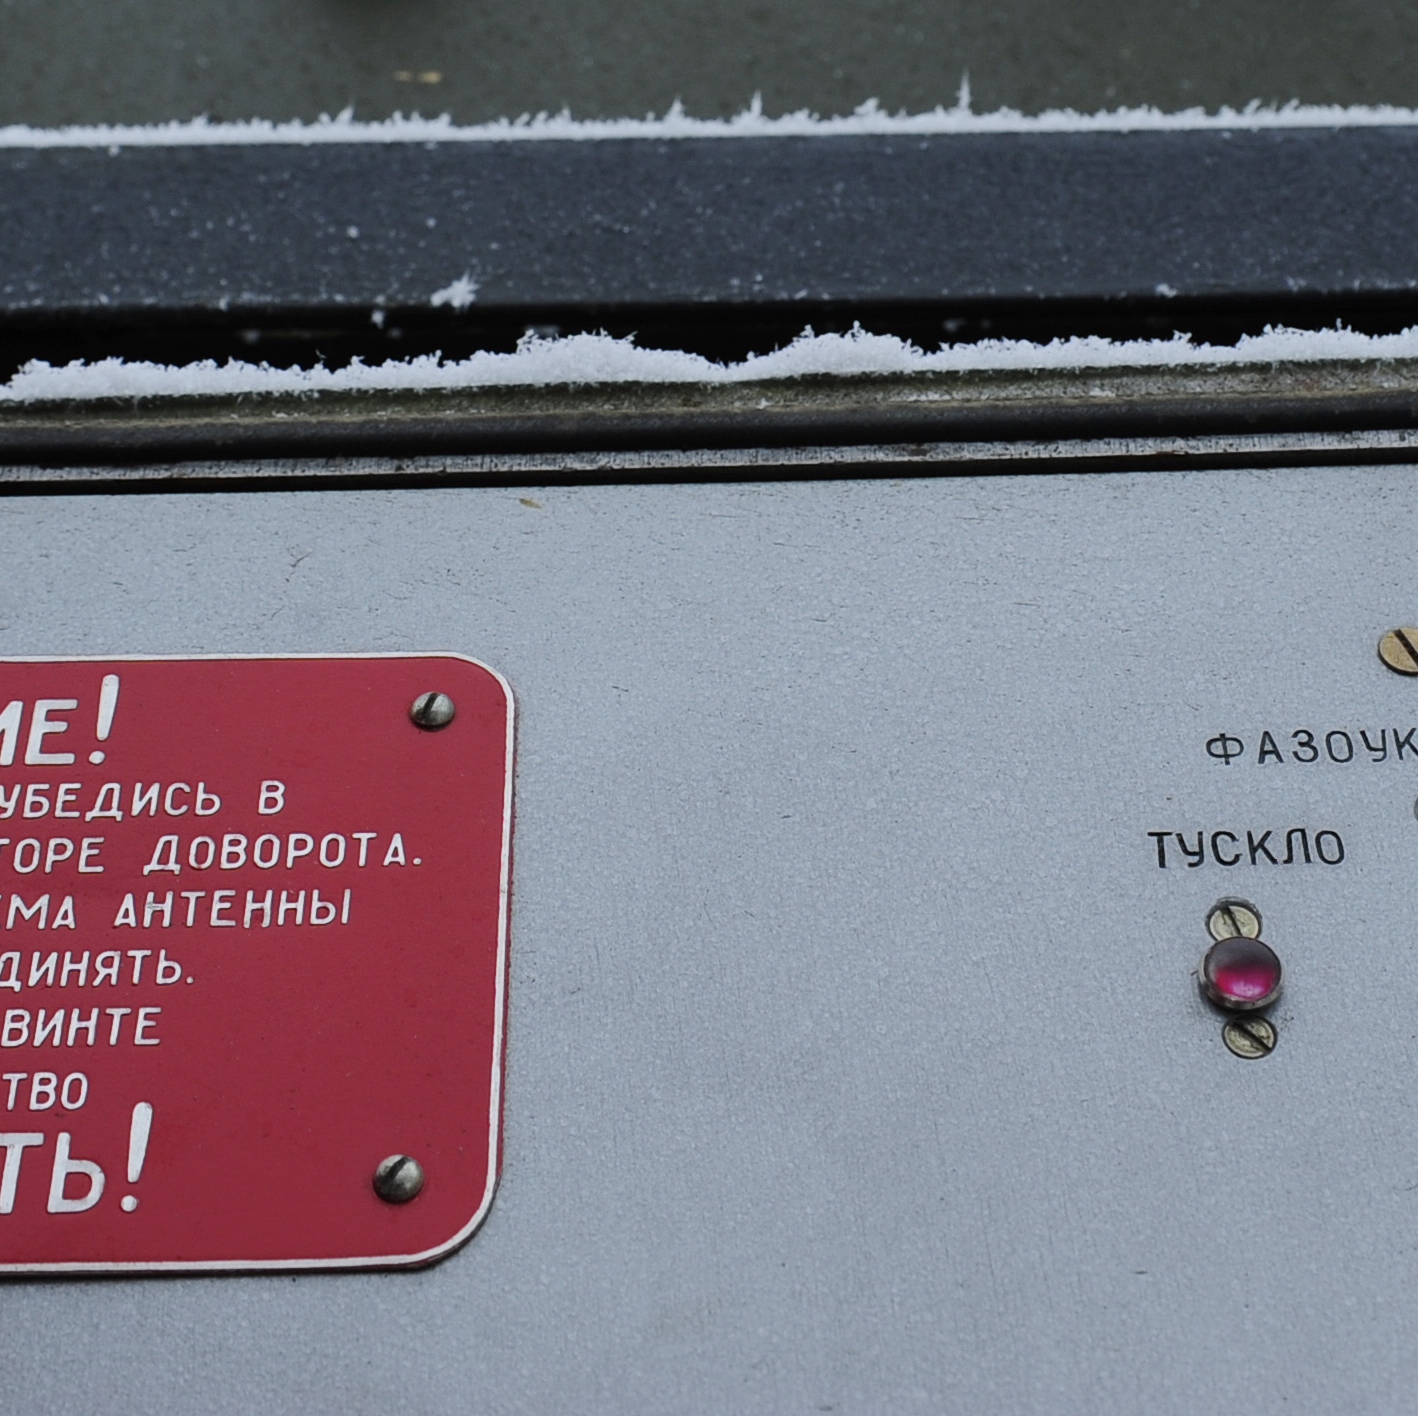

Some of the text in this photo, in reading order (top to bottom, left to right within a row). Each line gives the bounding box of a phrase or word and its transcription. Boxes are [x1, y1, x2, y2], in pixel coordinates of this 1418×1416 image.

[258, 780, 286, 815] В
[142, 832, 423, 876] ДОВОРОТА.
[1146, 828, 1347, 870] ТУСКЛО
[112, 888, 351, 929] АНТЕННЫ
[0, 1006, 162, 1047] ВИНТЕ
